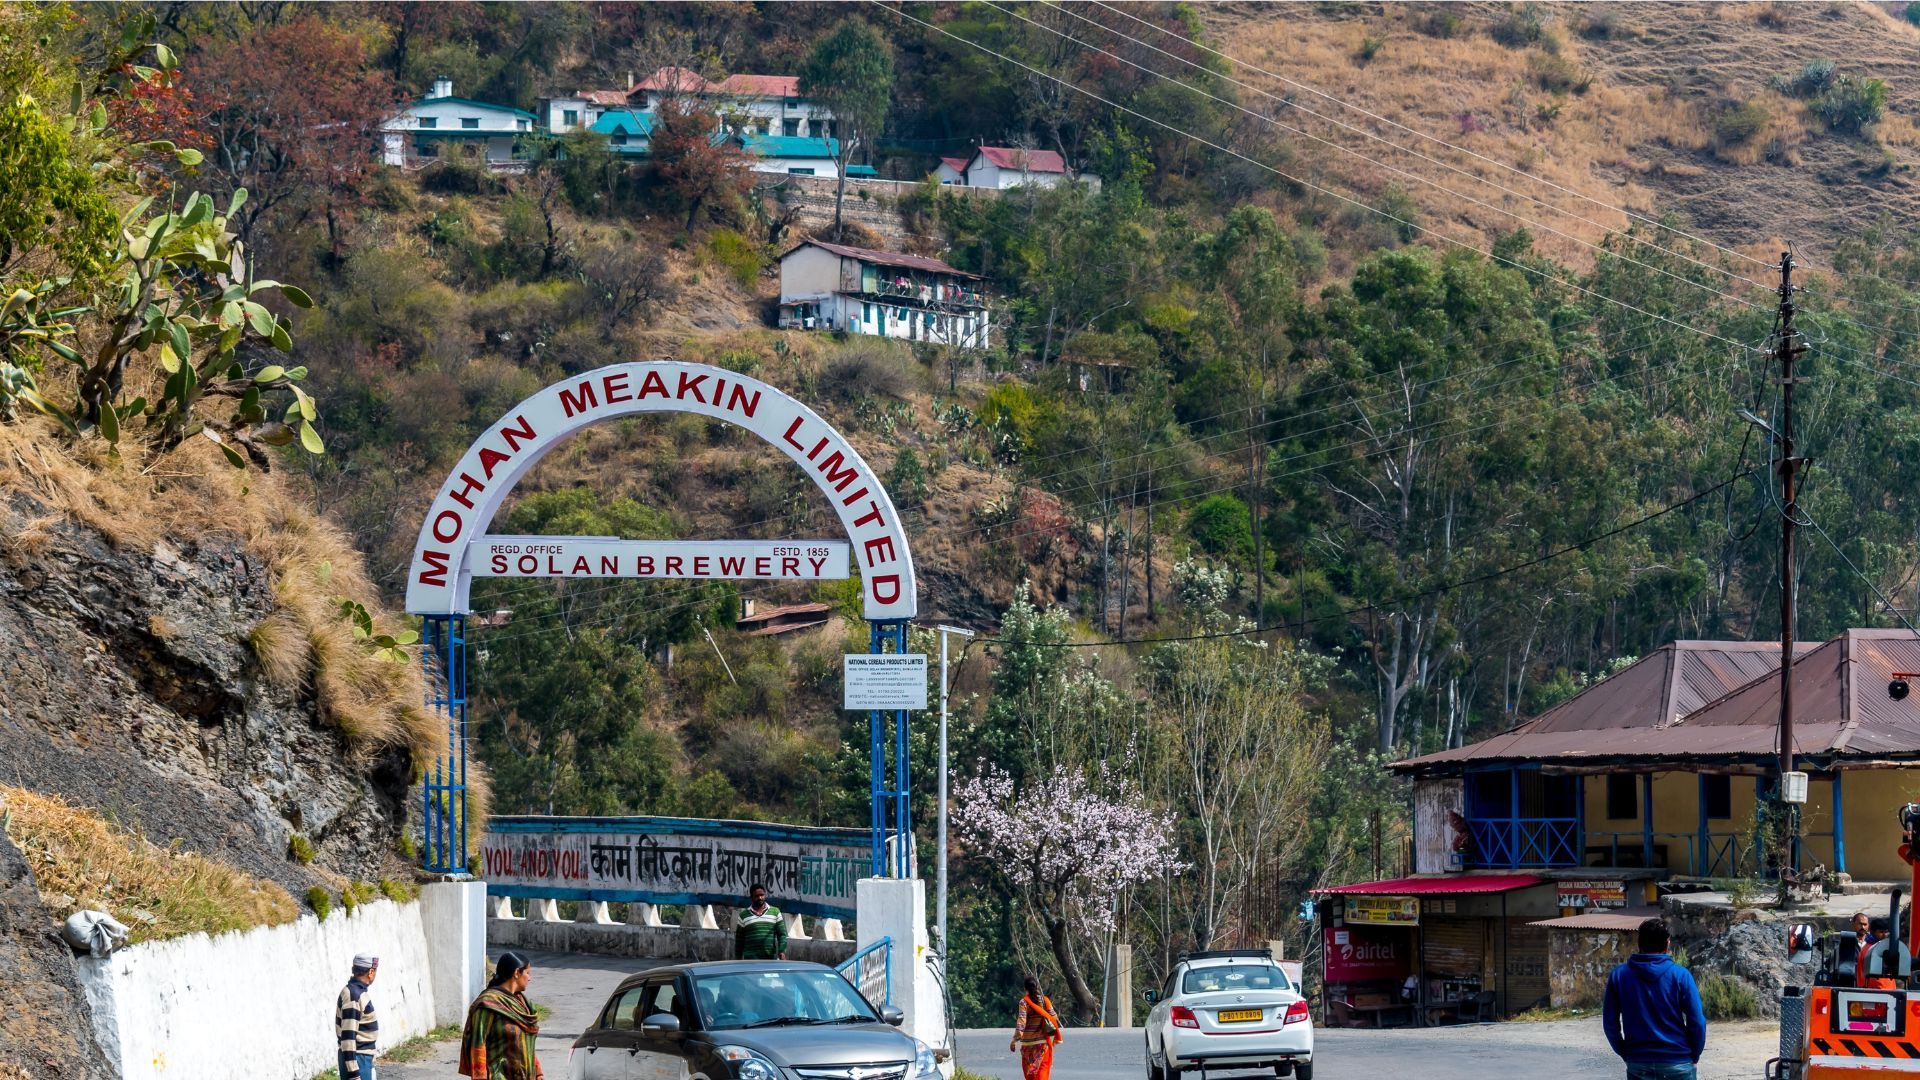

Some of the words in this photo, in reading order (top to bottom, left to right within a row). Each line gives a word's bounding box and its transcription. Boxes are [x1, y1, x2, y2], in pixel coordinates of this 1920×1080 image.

[419, 415, 538, 587] MOHAN
[558, 370, 762, 418] MEAKIN
[783, 415, 901, 605] LIMITED
[490, 544, 523, 554] REGD.
[525, 545, 563, 554] OFFICE
[773, 547, 803, 556] ESTD.
[806, 548, 829, 556] 1855
[491, 555, 619, 575] SOLAN
[636, 556, 827, 577] BREWERY
[520, 847, 548, 878] AND
[590, 844, 632, 883] काम
[714, 848, 764, 888] आराम
[764, 853, 800, 894] हराम
[1356, 942, 1395, 960] airtel
